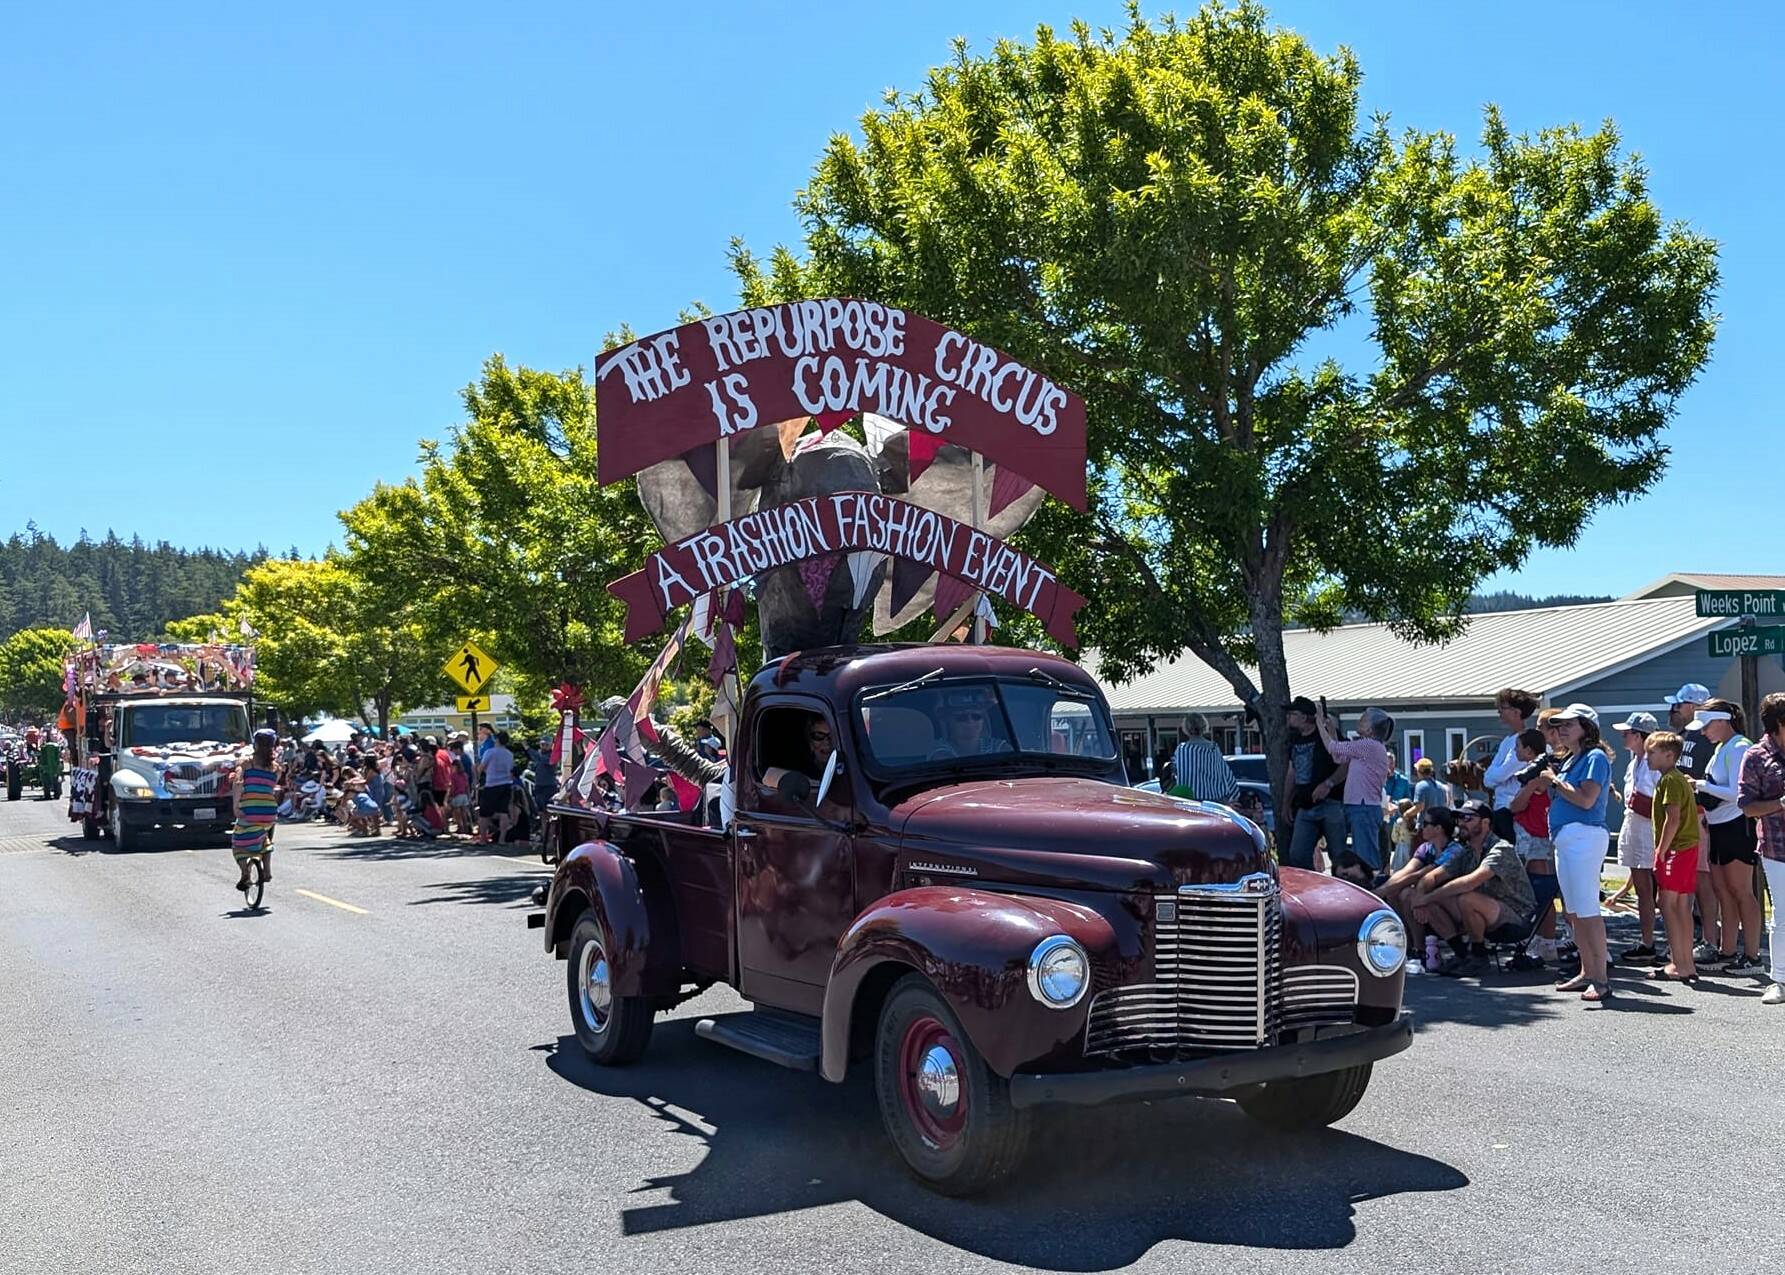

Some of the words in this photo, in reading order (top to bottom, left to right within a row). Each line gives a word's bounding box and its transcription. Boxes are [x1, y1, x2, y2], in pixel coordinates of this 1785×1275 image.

[598, 333, 691, 403] THE
[704, 298, 906, 371] REPURPOSE
[935, 330, 1068, 436] CIRCUS
[704, 373, 759, 436] IS
[792, 356, 956, 434] COMING
[655, 552, 699, 611] A
[678, 497, 830, 589] TRASHION
[828, 494, 960, 571] FASHION
[960, 531, 1057, 612] EVENT
[1701, 594, 1739, 614] Weeks
[1744, 593, 1776, 613] Point
[1715, 633, 1758, 657] Lopez
[1764, 639, 1775, 650] Rd
